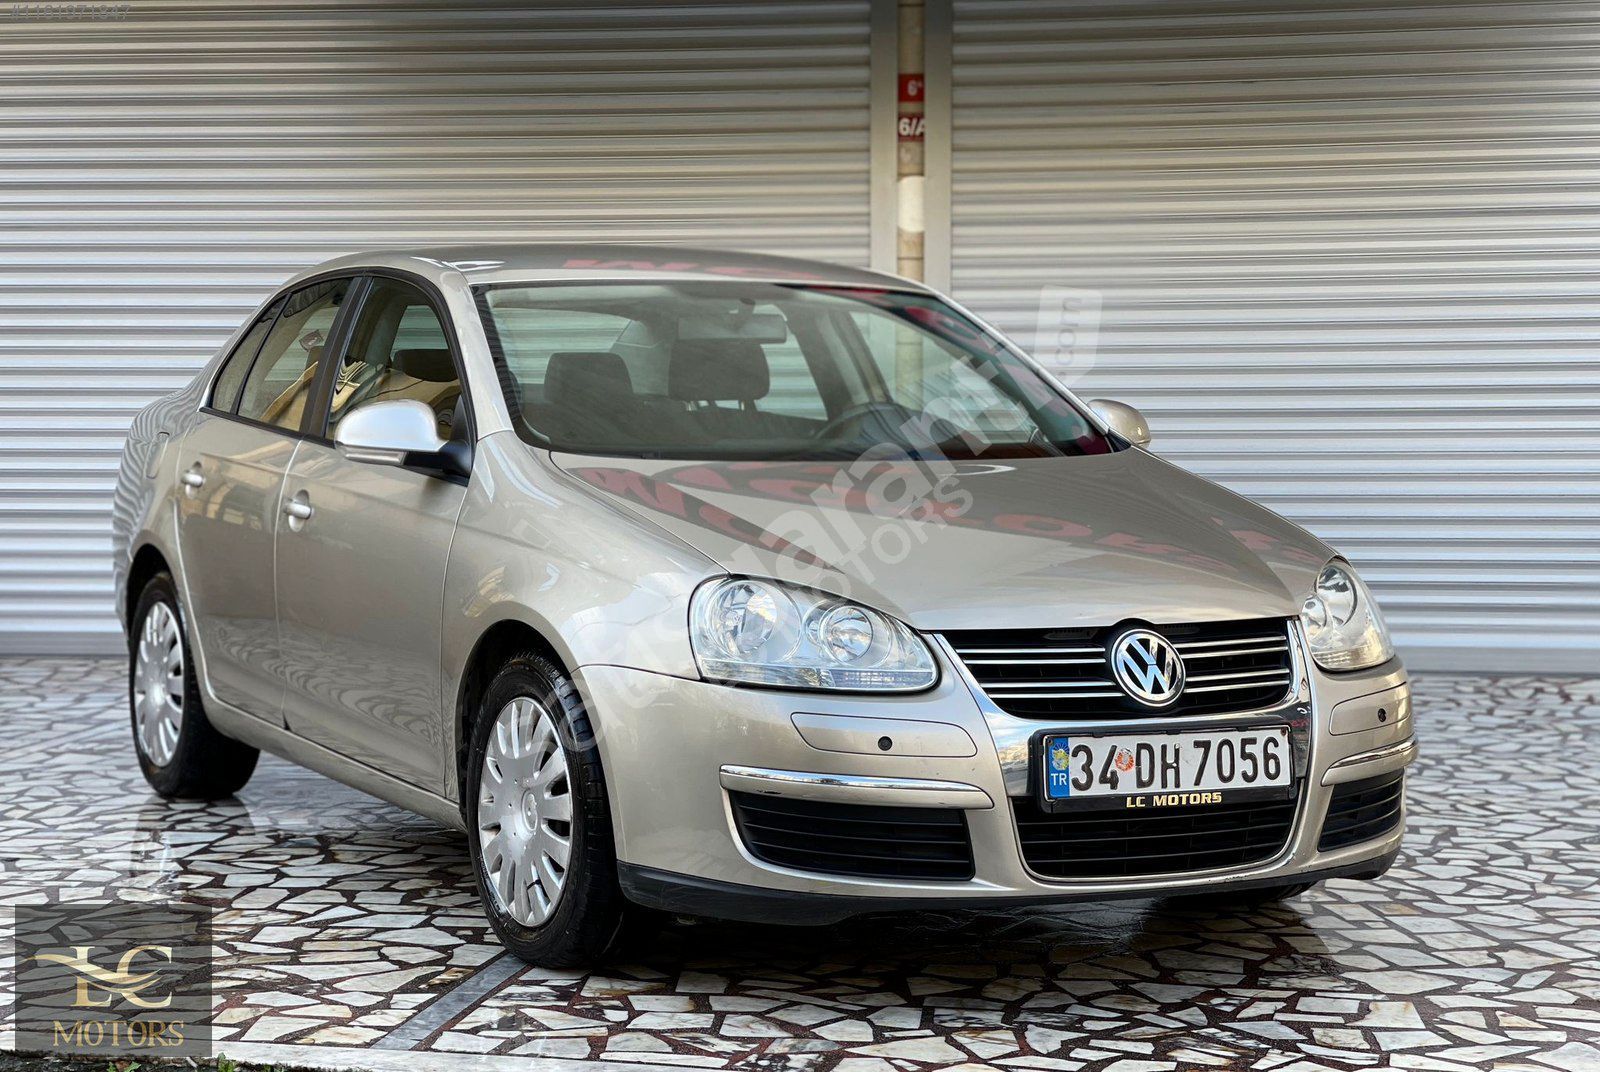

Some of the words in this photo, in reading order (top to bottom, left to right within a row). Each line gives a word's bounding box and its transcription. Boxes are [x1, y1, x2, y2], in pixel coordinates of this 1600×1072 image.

[1071, 744, 1119, 791] 34
[1135, 742, 1181, 789] DH
[1193, 736, 1282, 787] 7056
[1051, 773, 1068, 786] TR
[1126, 796, 1146, 809] LC
[1152, 791, 1223, 807] MOTORS
